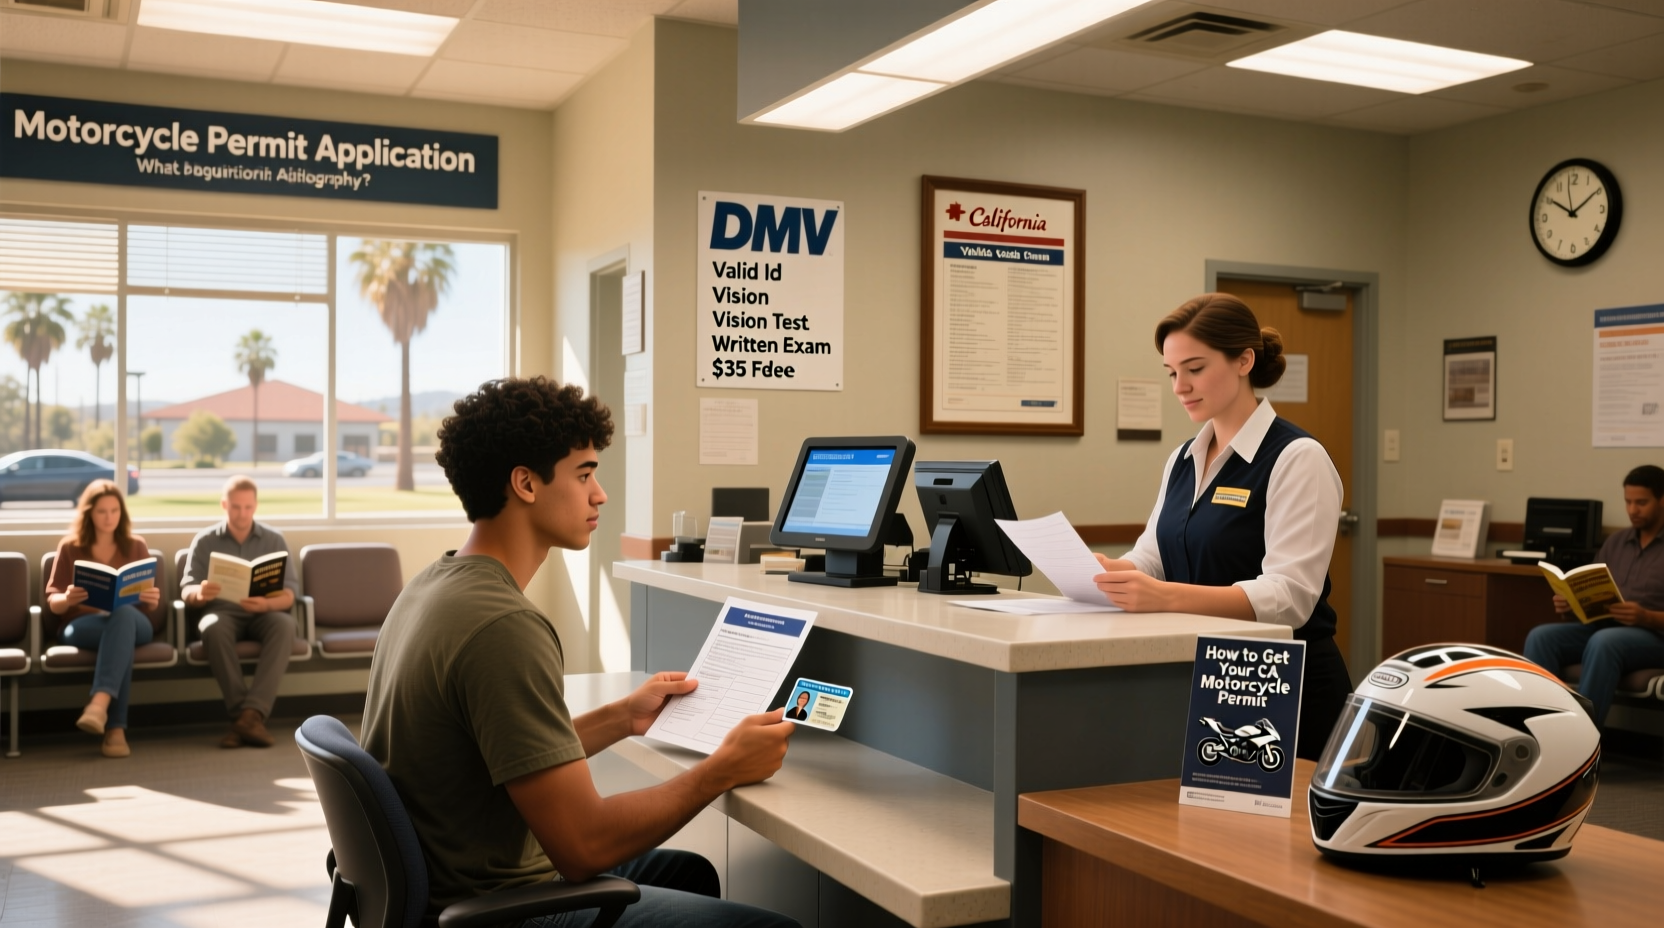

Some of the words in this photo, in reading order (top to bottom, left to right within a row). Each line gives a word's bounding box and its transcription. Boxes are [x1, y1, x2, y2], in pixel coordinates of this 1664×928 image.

[14, 109, 200, 155] Motorcycle
[207, 125, 308, 161] Permit
[315, 134, 476, 173] Application
[136, 157, 181, 176] What
[709, 201, 839, 256] DMV
[968, 206, 1047, 232] California
[712, 261, 759, 280] Valid
[765, 262, 782, 281] Id
[712, 286, 769, 305] Vision
[712, 310, 767, 329] Vision
[772, 312, 810, 331] Test
[712, 335, 778, 353] Written
[783, 336, 831, 354] Exam
[712, 357, 747, 380] $35
[1205, 645, 1239, 662] How
[1243, 648, 1258, 662] to
[1262, 649, 1290, 665] Get
[1219, 662, 1255, 677] Your
[1257, 665, 1280, 679] CA
[1200, 675, 1291, 696] Motorcycle
[1217, 691, 1268, 707] Permit
